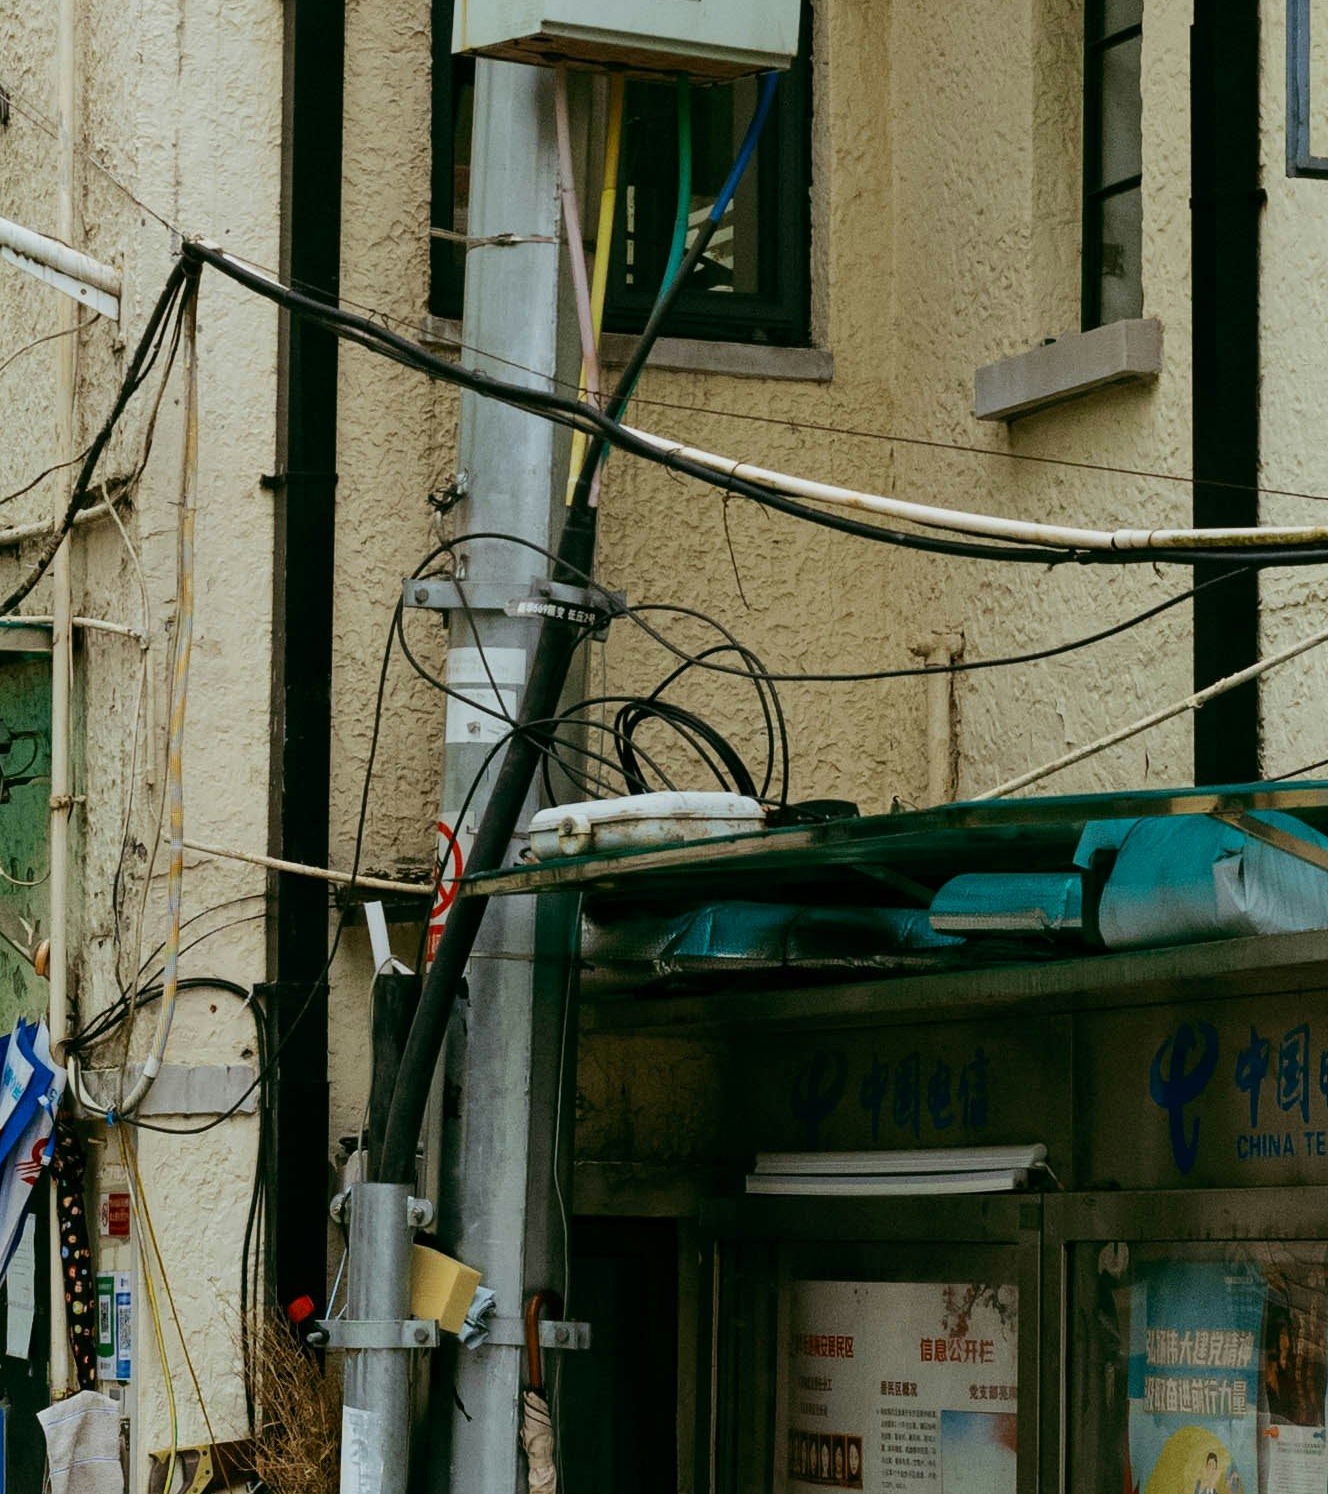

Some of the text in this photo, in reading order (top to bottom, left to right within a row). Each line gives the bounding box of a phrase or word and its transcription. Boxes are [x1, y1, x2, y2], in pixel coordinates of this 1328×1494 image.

[860, 1048, 991, 1139] 中国电信
[1237, 1133, 1295, 1159] CHINA
[920, 1338, 994, 1363] 信息公开栏
[1146, 1329, 1254, 1367] 弘扬伟大建党精神
